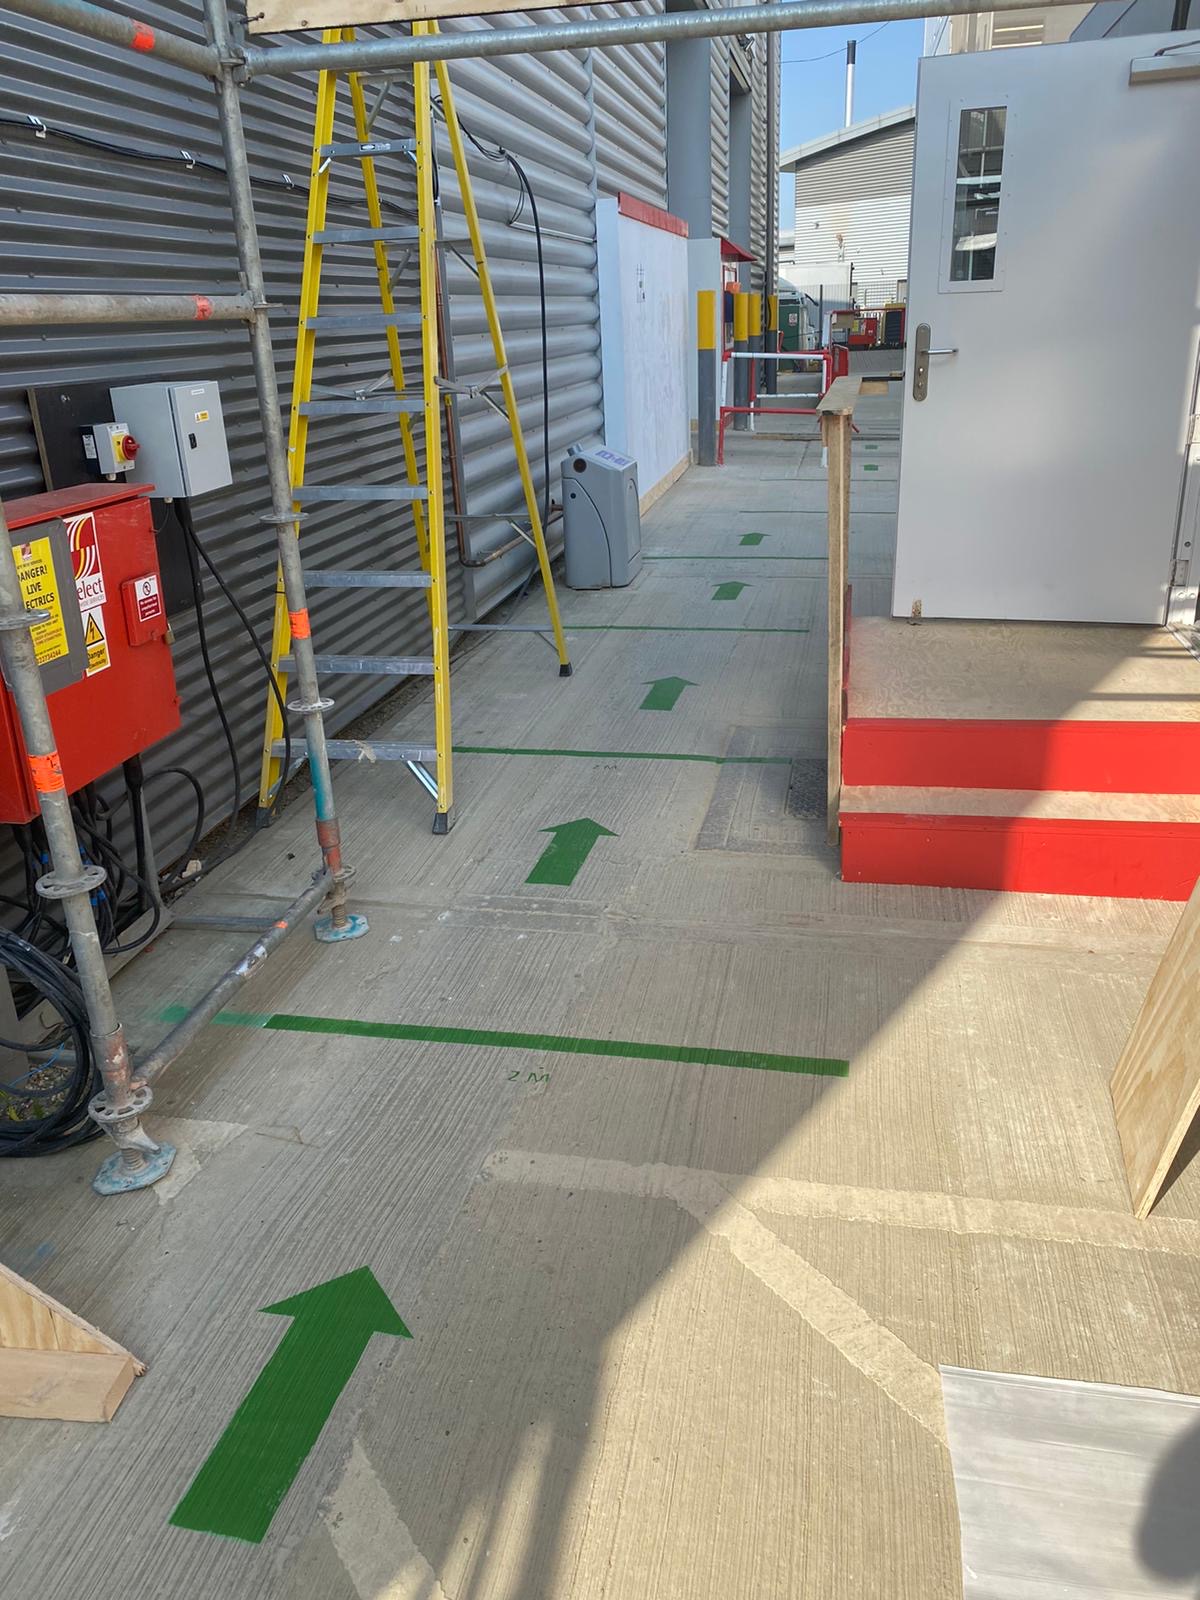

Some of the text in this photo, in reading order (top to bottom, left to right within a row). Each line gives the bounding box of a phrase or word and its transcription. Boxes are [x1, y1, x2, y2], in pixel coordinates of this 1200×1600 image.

[18, 564, 48, 582] ANGER!
[26, 581, 42, 595] LIVE
[77, 577, 104, 601] elect
[26, 592, 55, 609] ECTRICS
